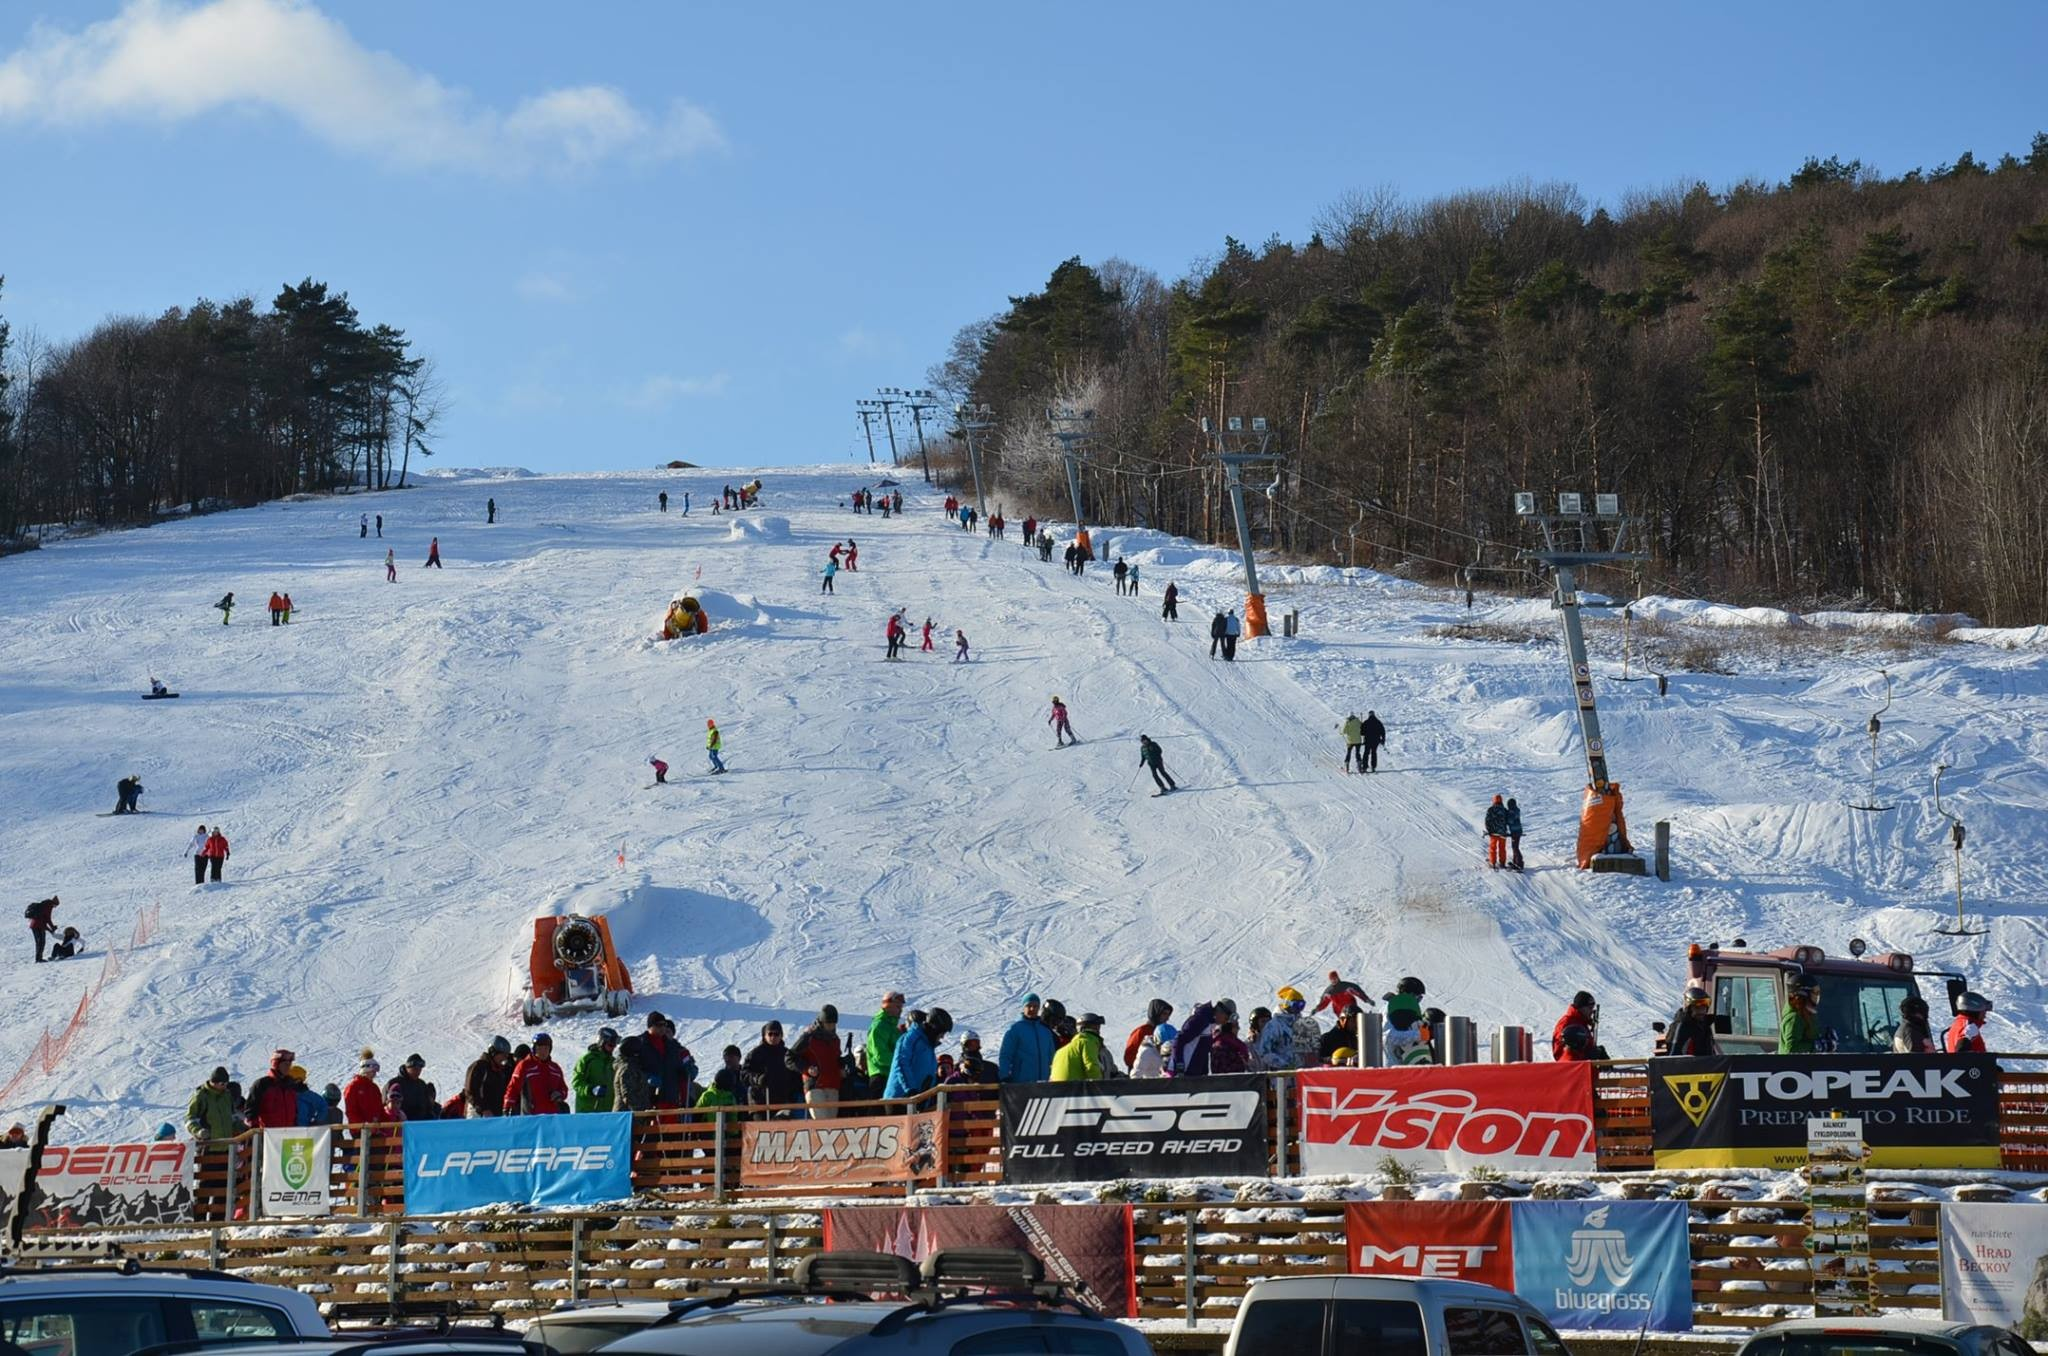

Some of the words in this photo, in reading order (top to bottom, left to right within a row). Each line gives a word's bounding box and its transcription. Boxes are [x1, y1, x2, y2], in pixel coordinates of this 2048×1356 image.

[1730, 1069, 1972, 1100] TOPEAK
[1858, 1109, 1896, 1124] TO
[1908, 1107, 1972, 1124] RIDE
[751, 1125, 899, 1164] MAXXIS
[1009, 1143, 1065, 1158] FULL
[1073, 1141, 1154, 1157] SPEED
[1160, 1138, 1243, 1154] AHEAD
[269, 1191, 322, 1202] DEMA
[1359, 1245, 1498, 1277] MET
[1555, 1287, 1651, 1315] bluegrass
